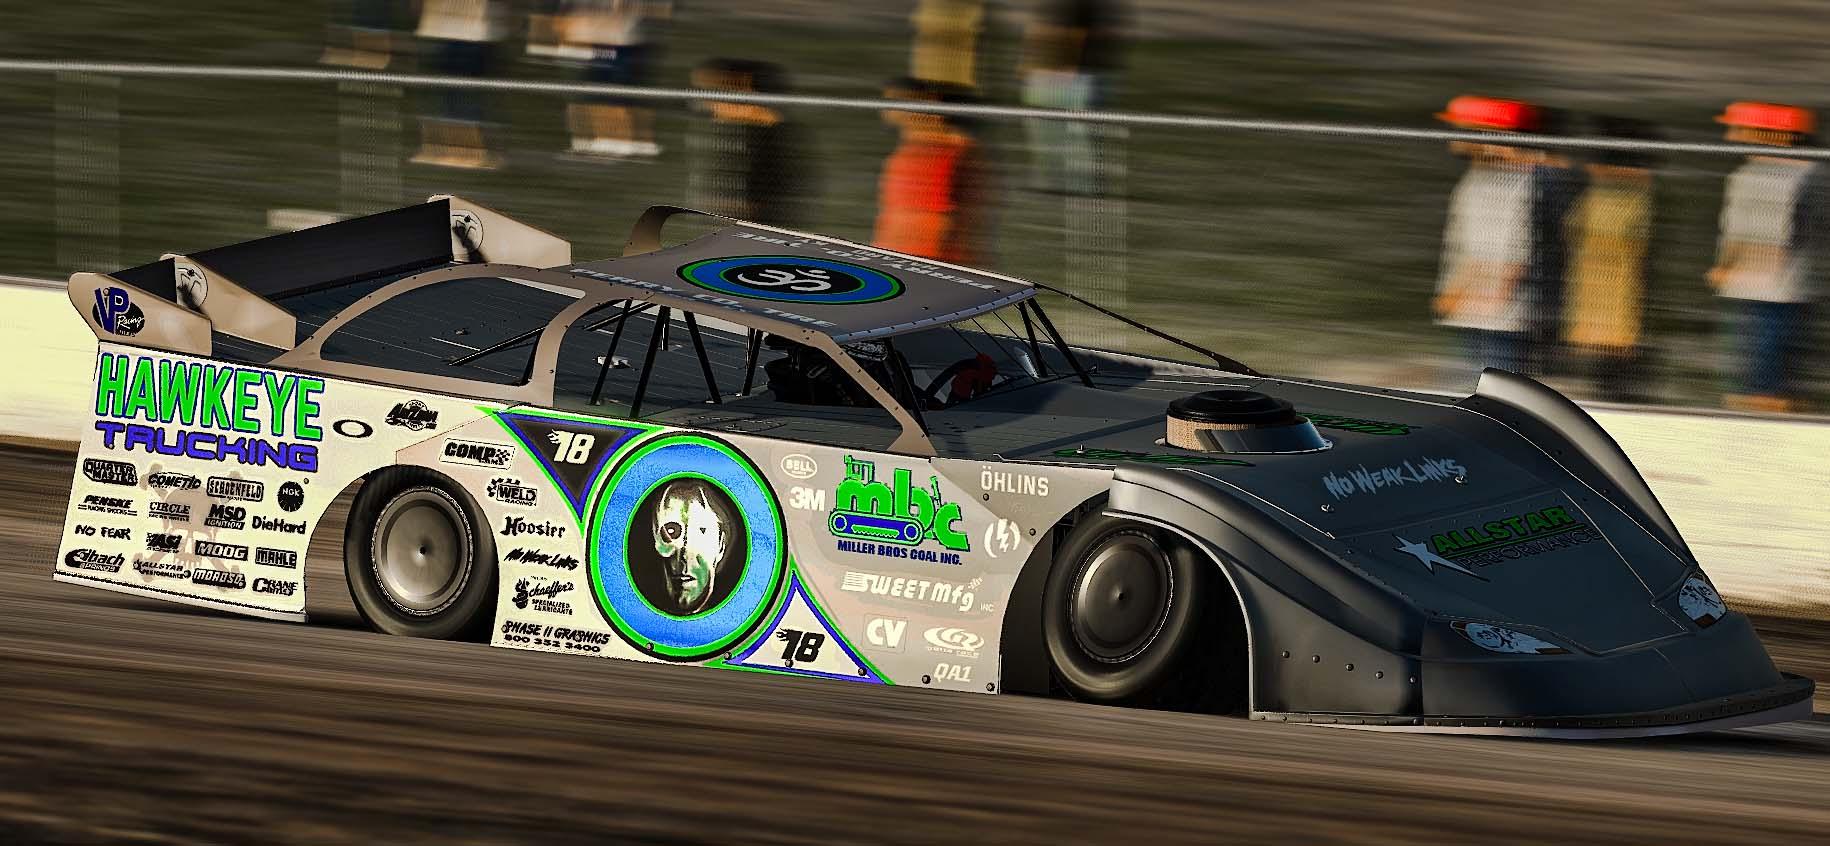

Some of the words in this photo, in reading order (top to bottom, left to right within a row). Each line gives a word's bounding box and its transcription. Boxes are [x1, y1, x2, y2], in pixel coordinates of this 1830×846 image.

[95, 287, 130, 334] VP
[117, 315, 145, 329] Racing
[95, 352, 325, 441] HAWKEYE
[95, 420, 318, 472] TRUCKING
[445, 442, 497, 461] COMP
[548, 429, 595, 464] 18
[786, 459, 814, 472] BELL
[148, 473, 201, 489] COMETIC
[209, 479, 261, 499] SCHOENFELD
[980, 465, 1049, 497] ÖHLINS
[84, 495, 133, 508] PENSKE
[282, 488, 300, 497] NGK
[497, 486, 537, 501] WELD
[789, 486, 826, 512] 3M
[149, 502, 191, 514] CIRCLE
[208, 503, 246, 521] MSD
[75, 525, 96, 536] NO
[101, 526, 131, 540] FEAR
[207, 519, 242, 529] IGNITION
[252, 516, 307, 534] DieHard
[500, 516, 566, 538] Hoosier
[1432, 505, 1577, 554] ALLSTAR
[197, 542, 247, 559] MOOG
[256, 548, 297, 567] MAHLE
[837, 540, 875, 555] MILLER
[877, 544, 908, 559] BROS
[910, 547, 938, 563] COAL
[940, 551, 963, 566] INC.
[1457, 527, 1603, 569] PERFORMANCE
[141, 562, 184, 572] ALLSTAR
[193, 568, 245, 585] MOROSO
[840, 571, 929, 600] SWEET
[505, 620, 542, 635] PHASE
[554, 628, 611, 645] GRAPHICS
[866, 618, 907, 649] CV
[776, 627, 825, 662] 18
[933, 662, 972, 683] QA1
